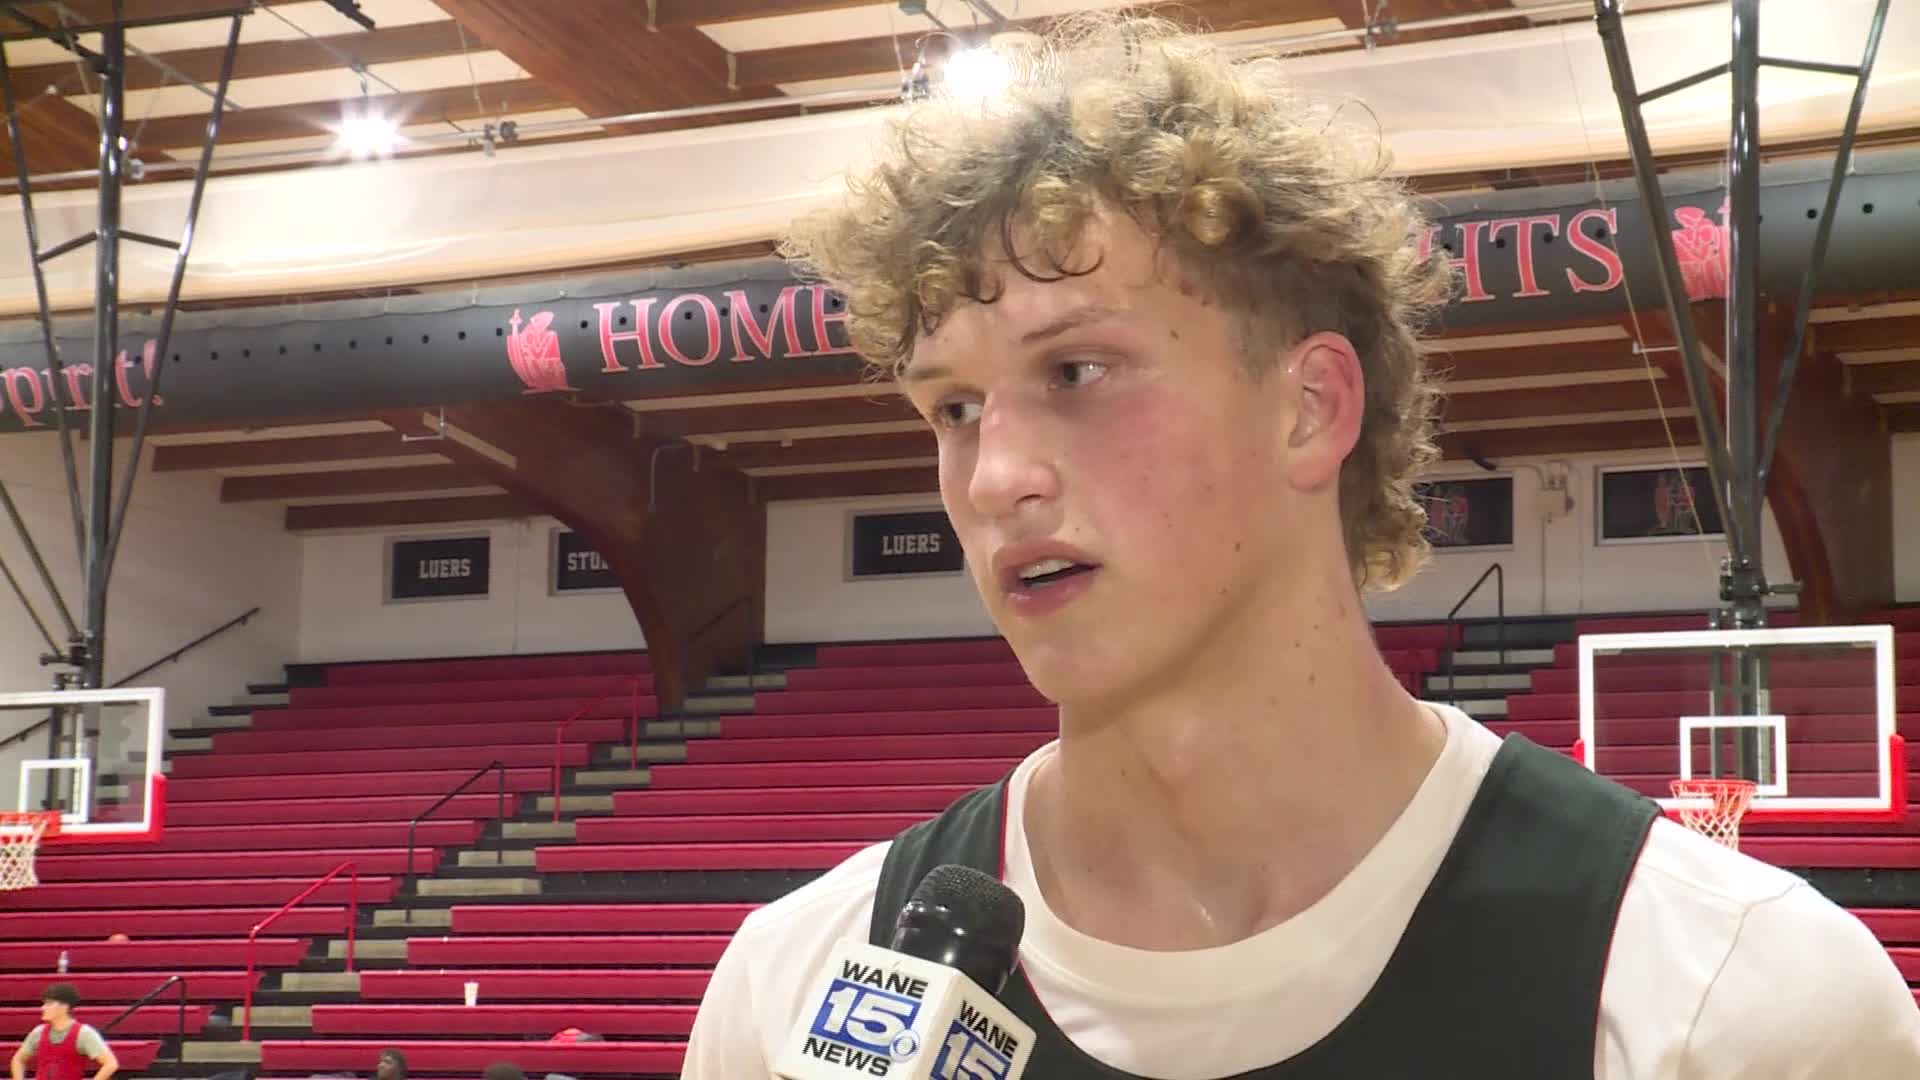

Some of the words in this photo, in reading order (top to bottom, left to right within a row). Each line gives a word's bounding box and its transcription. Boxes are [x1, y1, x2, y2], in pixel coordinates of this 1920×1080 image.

[1415, 206, 1624, 302] HTS
[593, 284, 855, 373] HOME
[419, 558, 471, 579] LUERS
[881, 533, 941, 556] LUERS
[841, 960, 928, 999] WANE
[822, 985, 915, 1047] 15
[960, 1000, 1018, 1059] WANE
[802, 1037, 892, 1077] NEWS
